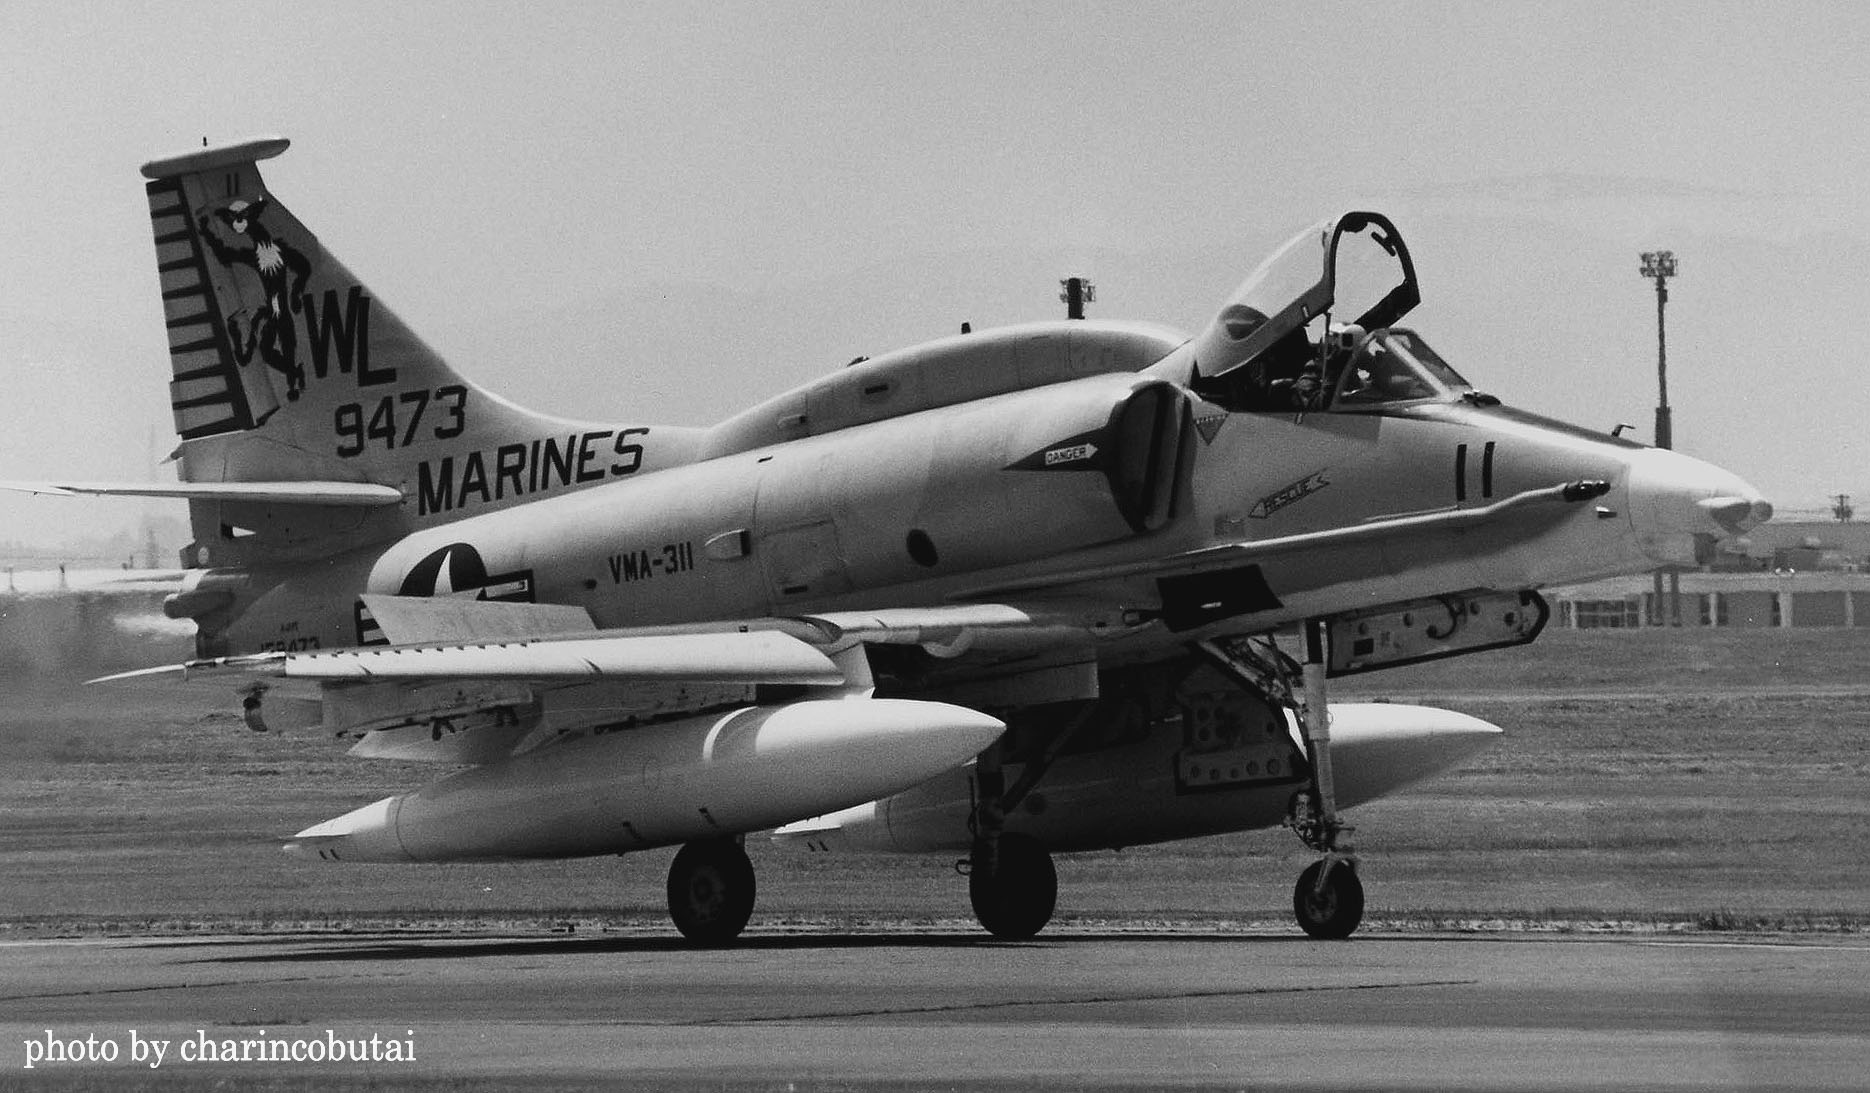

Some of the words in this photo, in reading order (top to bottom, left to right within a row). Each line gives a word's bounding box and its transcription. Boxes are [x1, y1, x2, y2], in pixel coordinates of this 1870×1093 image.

[226, 172, 240, 196] 11
[302, 285, 396, 387] WL
[335, 385, 467, 458] 9473
[417, 427, 650, 516] MARINES
[1046, 446, 1087, 464] DANGER
[1455, 440, 1496, 501] 11
[1263, 479, 1313, 515] RESCUE
[608, 541, 694, 585] VMA-311
